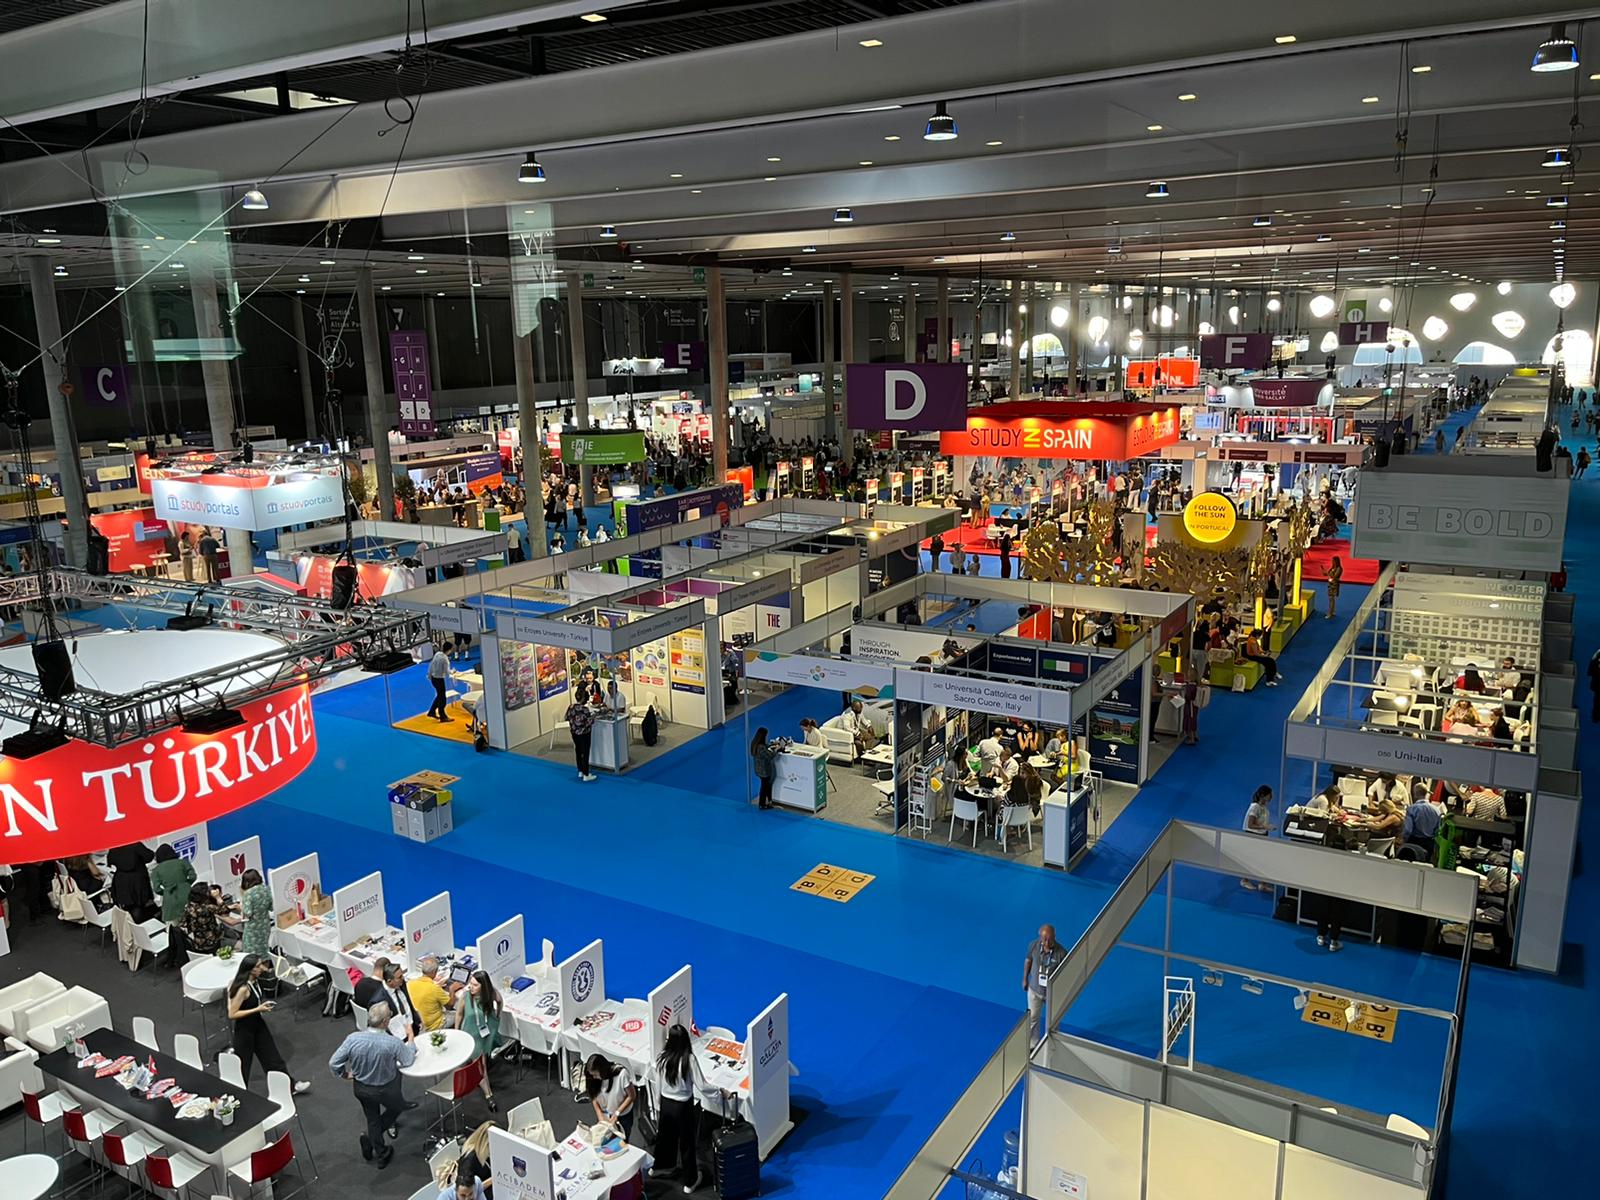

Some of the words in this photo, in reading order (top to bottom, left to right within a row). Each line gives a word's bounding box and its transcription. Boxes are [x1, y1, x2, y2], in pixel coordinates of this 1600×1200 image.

[1355, 324, 1372, 342] H
[677, 343, 692, 365] E
[1225, 337, 1248, 364] F
[97, 367, 117, 402] C
[885, 369, 927, 421] D
[571, 439, 593, 450] EAIE
[970, 427, 1022, 447] STUDY
[1043, 428, 1093, 449] SPAIN
[181, 499, 240, 516] studyportals
[280, 494, 333, 512] studyportals
[1368, 503, 1421, 531] BE
[1435, 506, 1554, 539] BOLD
[1506, 584, 1544, 594] OFFER
[766, 613, 781, 628] THE
[542, 629, 566, 640] University
[571, 633, 589, 643] Türkiye
[859, 638, 891, 648] THROUGH
[945, 682, 982, 695] Università
[983, 688, 1018, 702] Cattolica
[1019, 694, 1032, 702] del
[954, 693, 976, 705] Sacro
[978, 698, 1002, 709] Cuore,
[1005, 703, 1022, 713] Italy
[82, 691, 311, 822] TÜRKİYE
[1394, 750, 1443, 765] Uni-Italia
[834, 889, 849, 897] B
[354, 893, 379, 912] BEYKOZ
[1312, 1009, 1331, 1020] B
[1366, 1022, 1386, 1033] B
[496, 1170, 547, 1198] ACIBADEM
